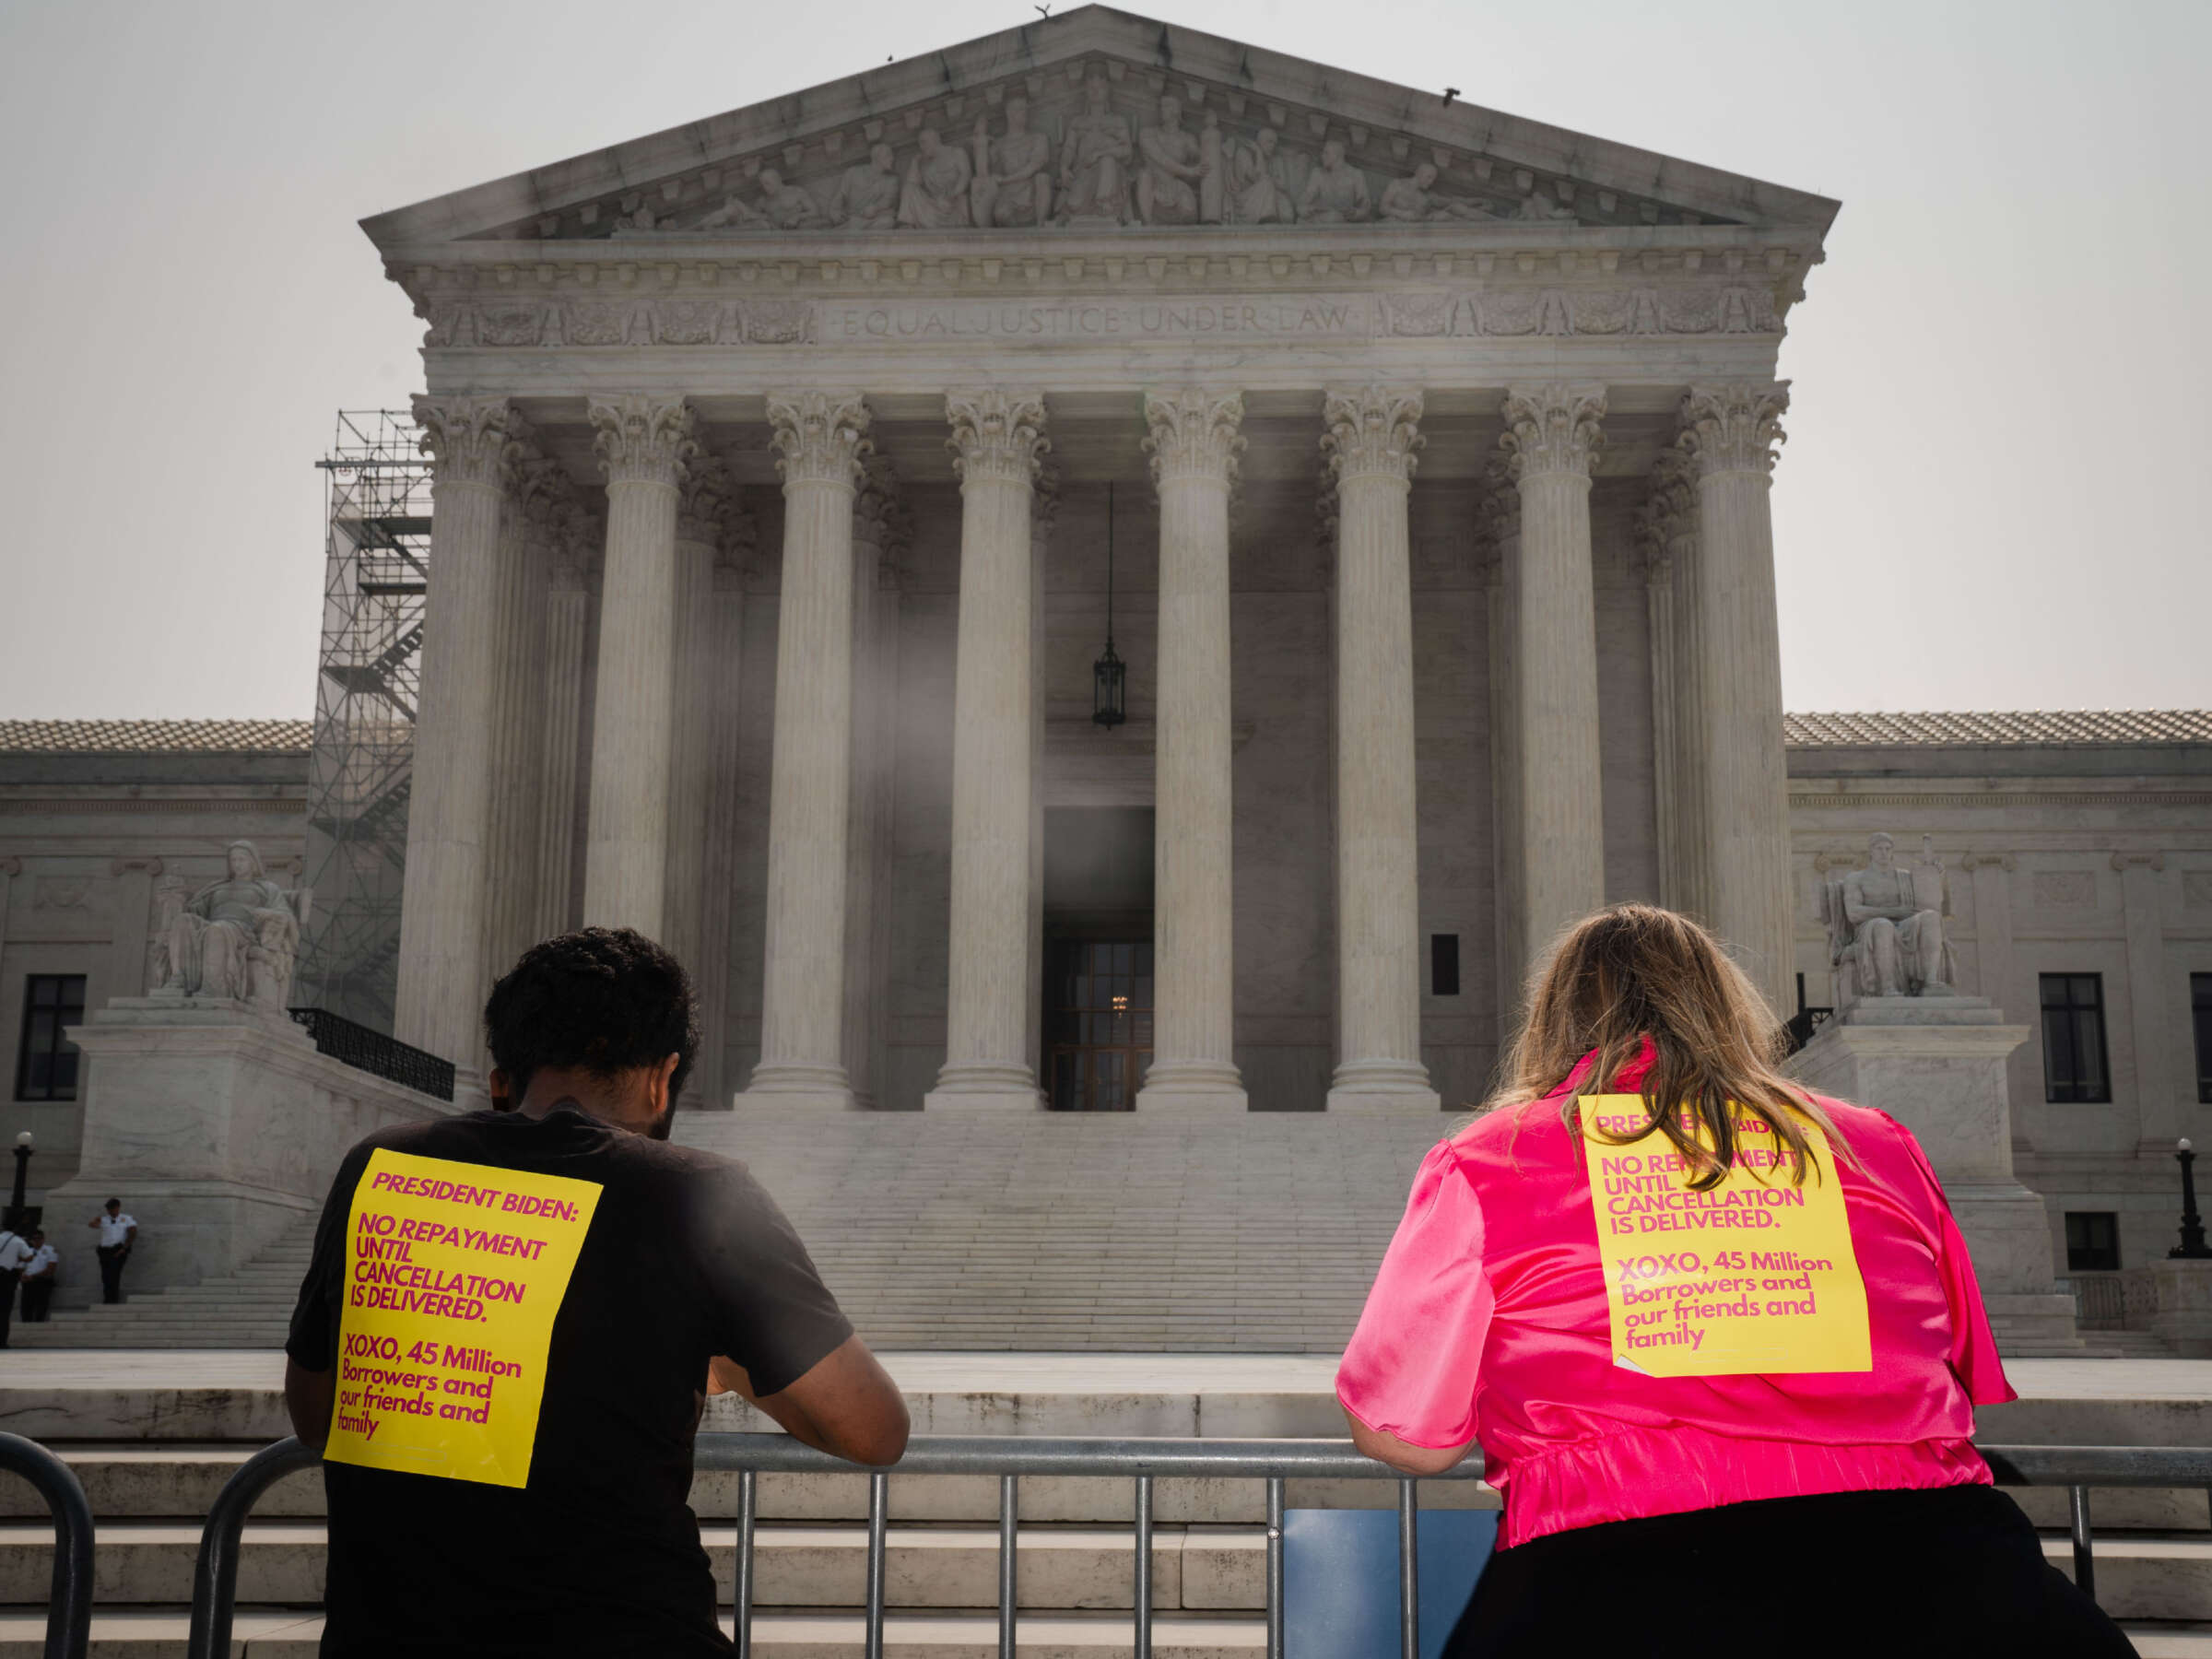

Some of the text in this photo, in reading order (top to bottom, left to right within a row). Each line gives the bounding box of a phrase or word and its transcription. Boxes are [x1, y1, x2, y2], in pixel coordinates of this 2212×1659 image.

[841, 302, 1349, 337] EQUAL JUSTICE UNDER LAW
[1601, 1155, 1642, 1176] NO
[371, 1172, 579, 1222] PRESIDENT BIDEN:
[1604, 1175, 1677, 1194] UNTIL
[1607, 1188, 1805, 1215] CANCELLATION
[358, 1213, 547, 1260] NO REPAYMENT
[1611, 1209, 1781, 1235] IS DELIVERED.
[356, 1237, 413, 1263] UNTIL
[1618, 1252, 1833, 1281] XOXO, 45 Million
[354, 1261, 526, 1304] CANCELLATION
[1621, 1272, 1812, 1306] Borrowers and
[350, 1285, 487, 1323] IS DELIVERED.
[1624, 1292, 1817, 1327] our friends and
[1625, 1322, 1705, 1350] family
[344, 1333, 522, 1378] XOXO, 45 Million
[343, 1358, 493, 1399] Borrowers and
[340, 1385, 490, 1424] our friends and
[337, 1409, 380, 1441] family
